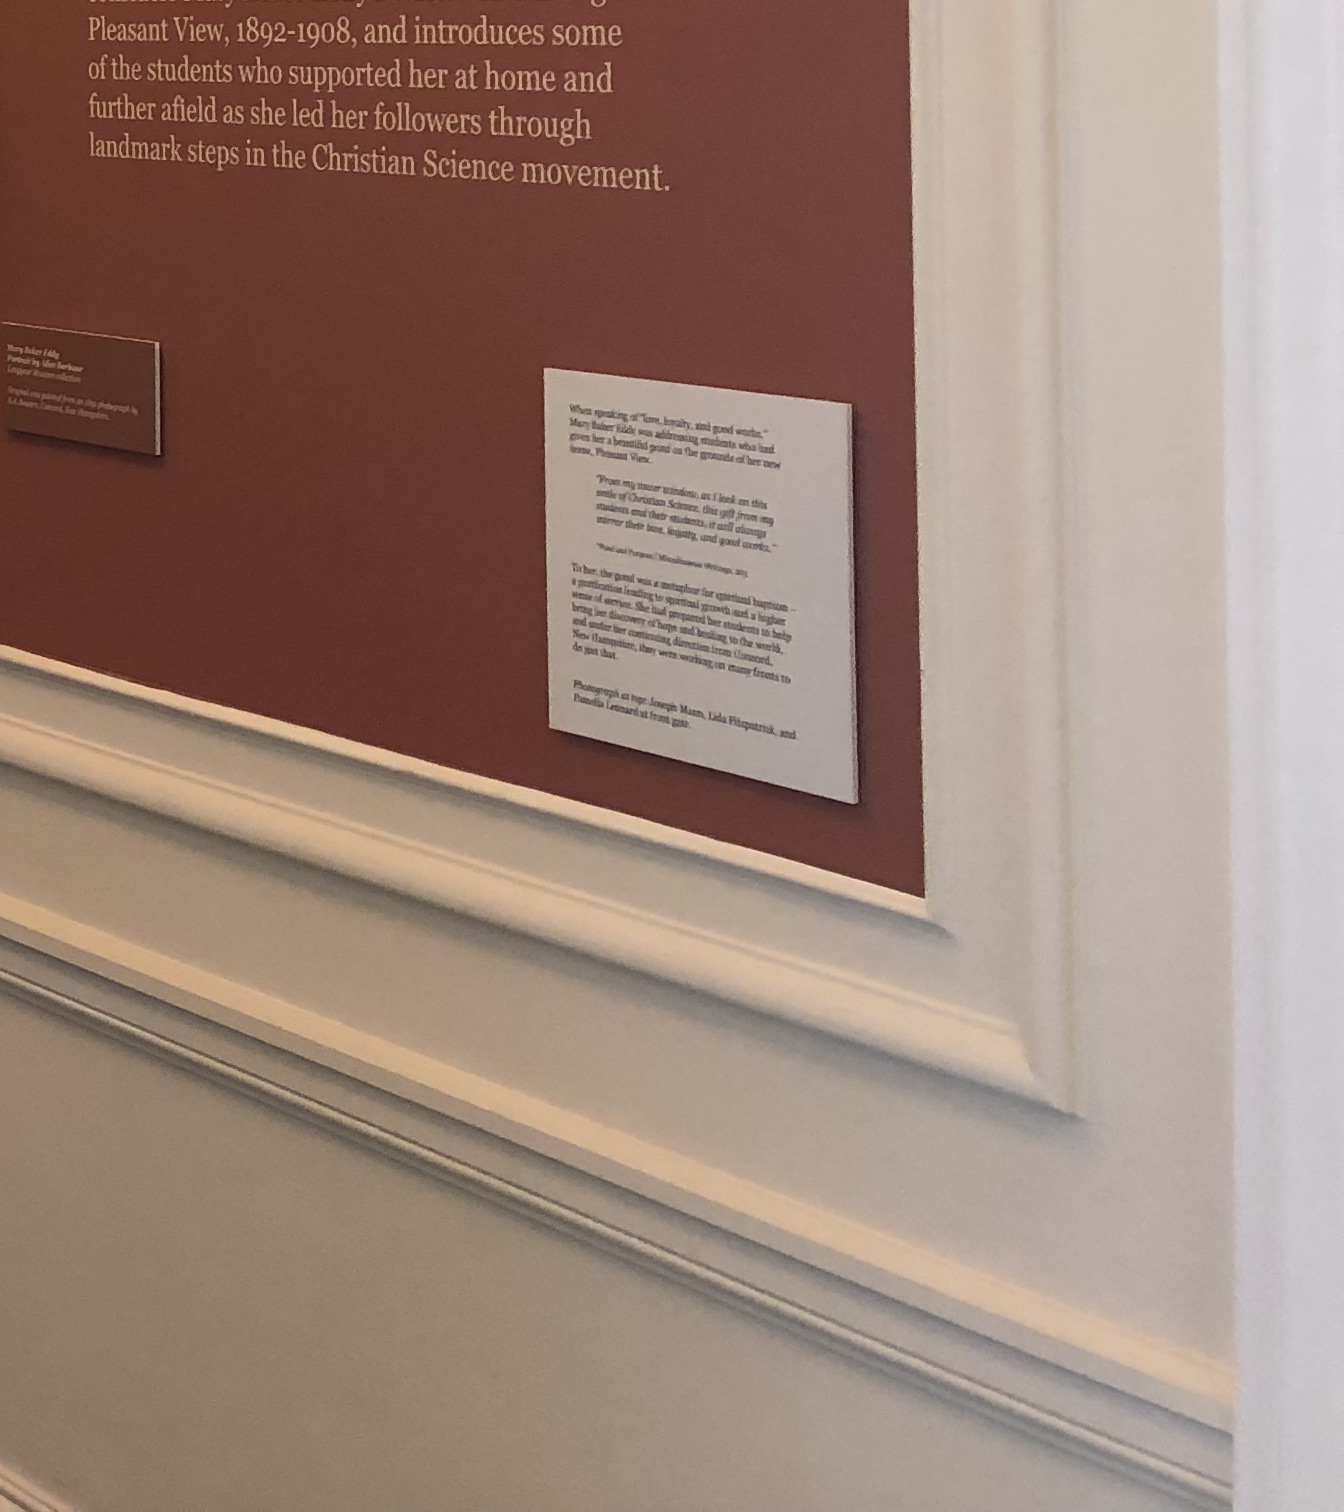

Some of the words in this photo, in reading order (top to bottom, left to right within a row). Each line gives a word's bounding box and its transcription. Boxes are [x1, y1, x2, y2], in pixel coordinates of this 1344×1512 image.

[88, 17, 168, 42] Pleasant
[173, 17, 230, 46] View,
[236, 16, 358, 49] 1892-1908,
[364, 16, 407, 44] and
[414, 16, 544, 46] introduces
[552, 23, 622, 47] some
[88, 54, 109, 81] of
[111, 57, 142, 82] the
[146, 58, 232, 83] students
[238, 59, 282, 84] who
[288, 58, 402, 93] supported
[409, 60, 448, 90] her
[454, 65, 478, 90] at
[484, 62, 556, 92] home
[563, 62, 613, 94] and
[88, 94, 156, 122] further
[161, 96, 216, 124] afield
[222, 105, 244, 124] as
[250, 100, 286, 126] she
[292, 100, 324, 128] led
[330, 102, 368, 130] her
[374, 102, 482, 134] followers
[488, 106, 590, 145] through
[88, 133, 182, 162] landmark
[187, 142, 240, 170] steps
[245, 140, 266, 166] in
[272, 142, 306, 169] the
[312, 144, 415, 176] Christian
[422, 151, 514, 181] Science
[521, 162, 670, 192] movement.
